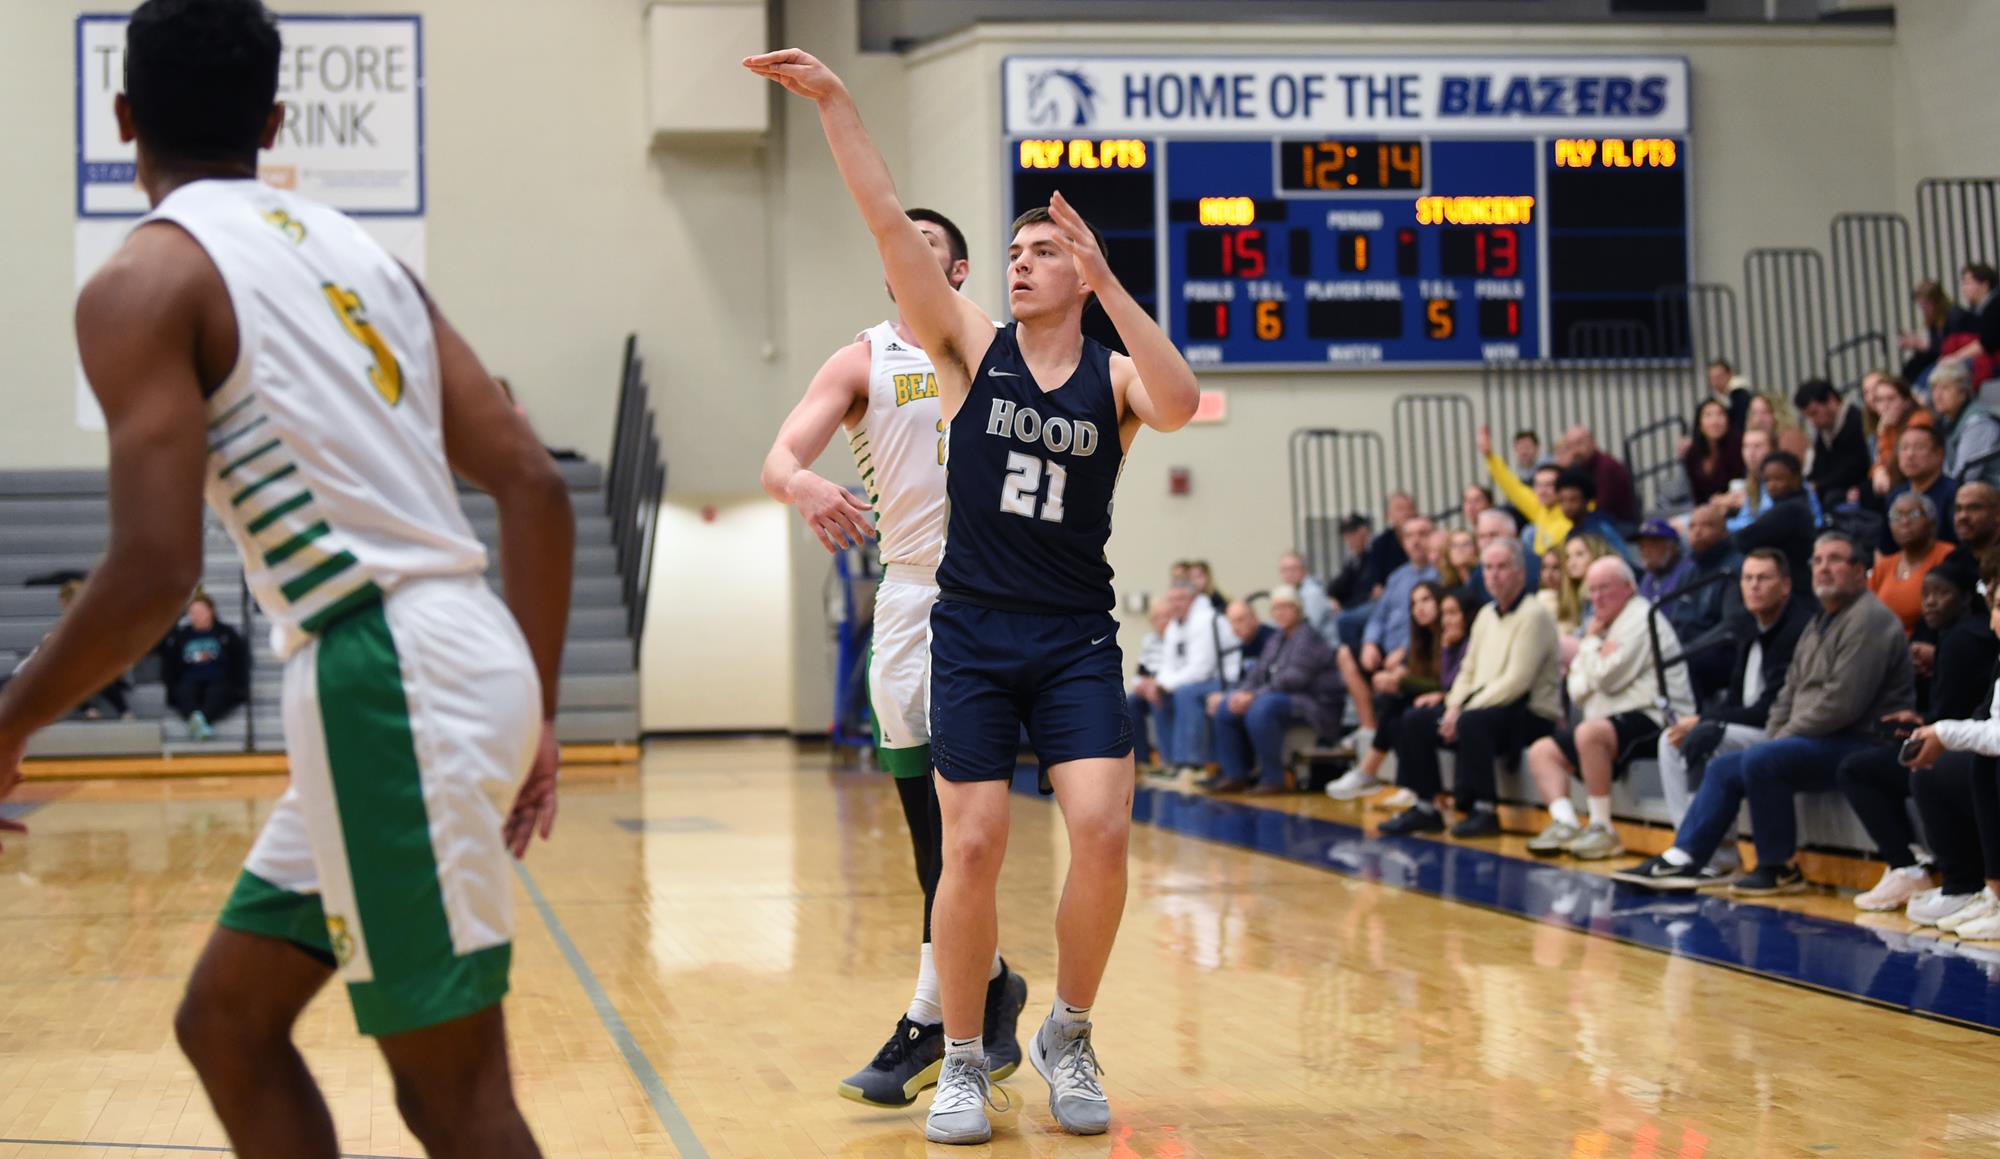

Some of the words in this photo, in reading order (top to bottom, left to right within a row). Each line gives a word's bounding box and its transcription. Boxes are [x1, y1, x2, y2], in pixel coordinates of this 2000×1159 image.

[280, 45, 407, 93] EFORE
[1124, 73, 1256, 119] HOME
[1269, 73, 1325, 119] OF
[1337, 73, 1421, 119] THE
[1437, 75, 1668, 119] BLAZERS
[280, 101, 378, 147] RINK
[1100, 139, 1147, 169] PTS
[1302, 140, 1421, 191] 12:14
[1632, 138, 1677, 168] PTS
[1221, 228, 1265, 279] 15
[1354, 233, 1368, 272] 1
[1474, 228, 1518, 278] 13
[1215, 302, 1228, 338] 1
[1255, 299, 1283, 340] 6
[1426, 298, 1454, 339] 5
[1507, 300, 1519, 335] 1
[321, 280, 404, 406] 5
[893, 372, 939, 408] BEA
[986, 397, 1099, 457] HOOD
[1000, 450, 1068, 523] 21
